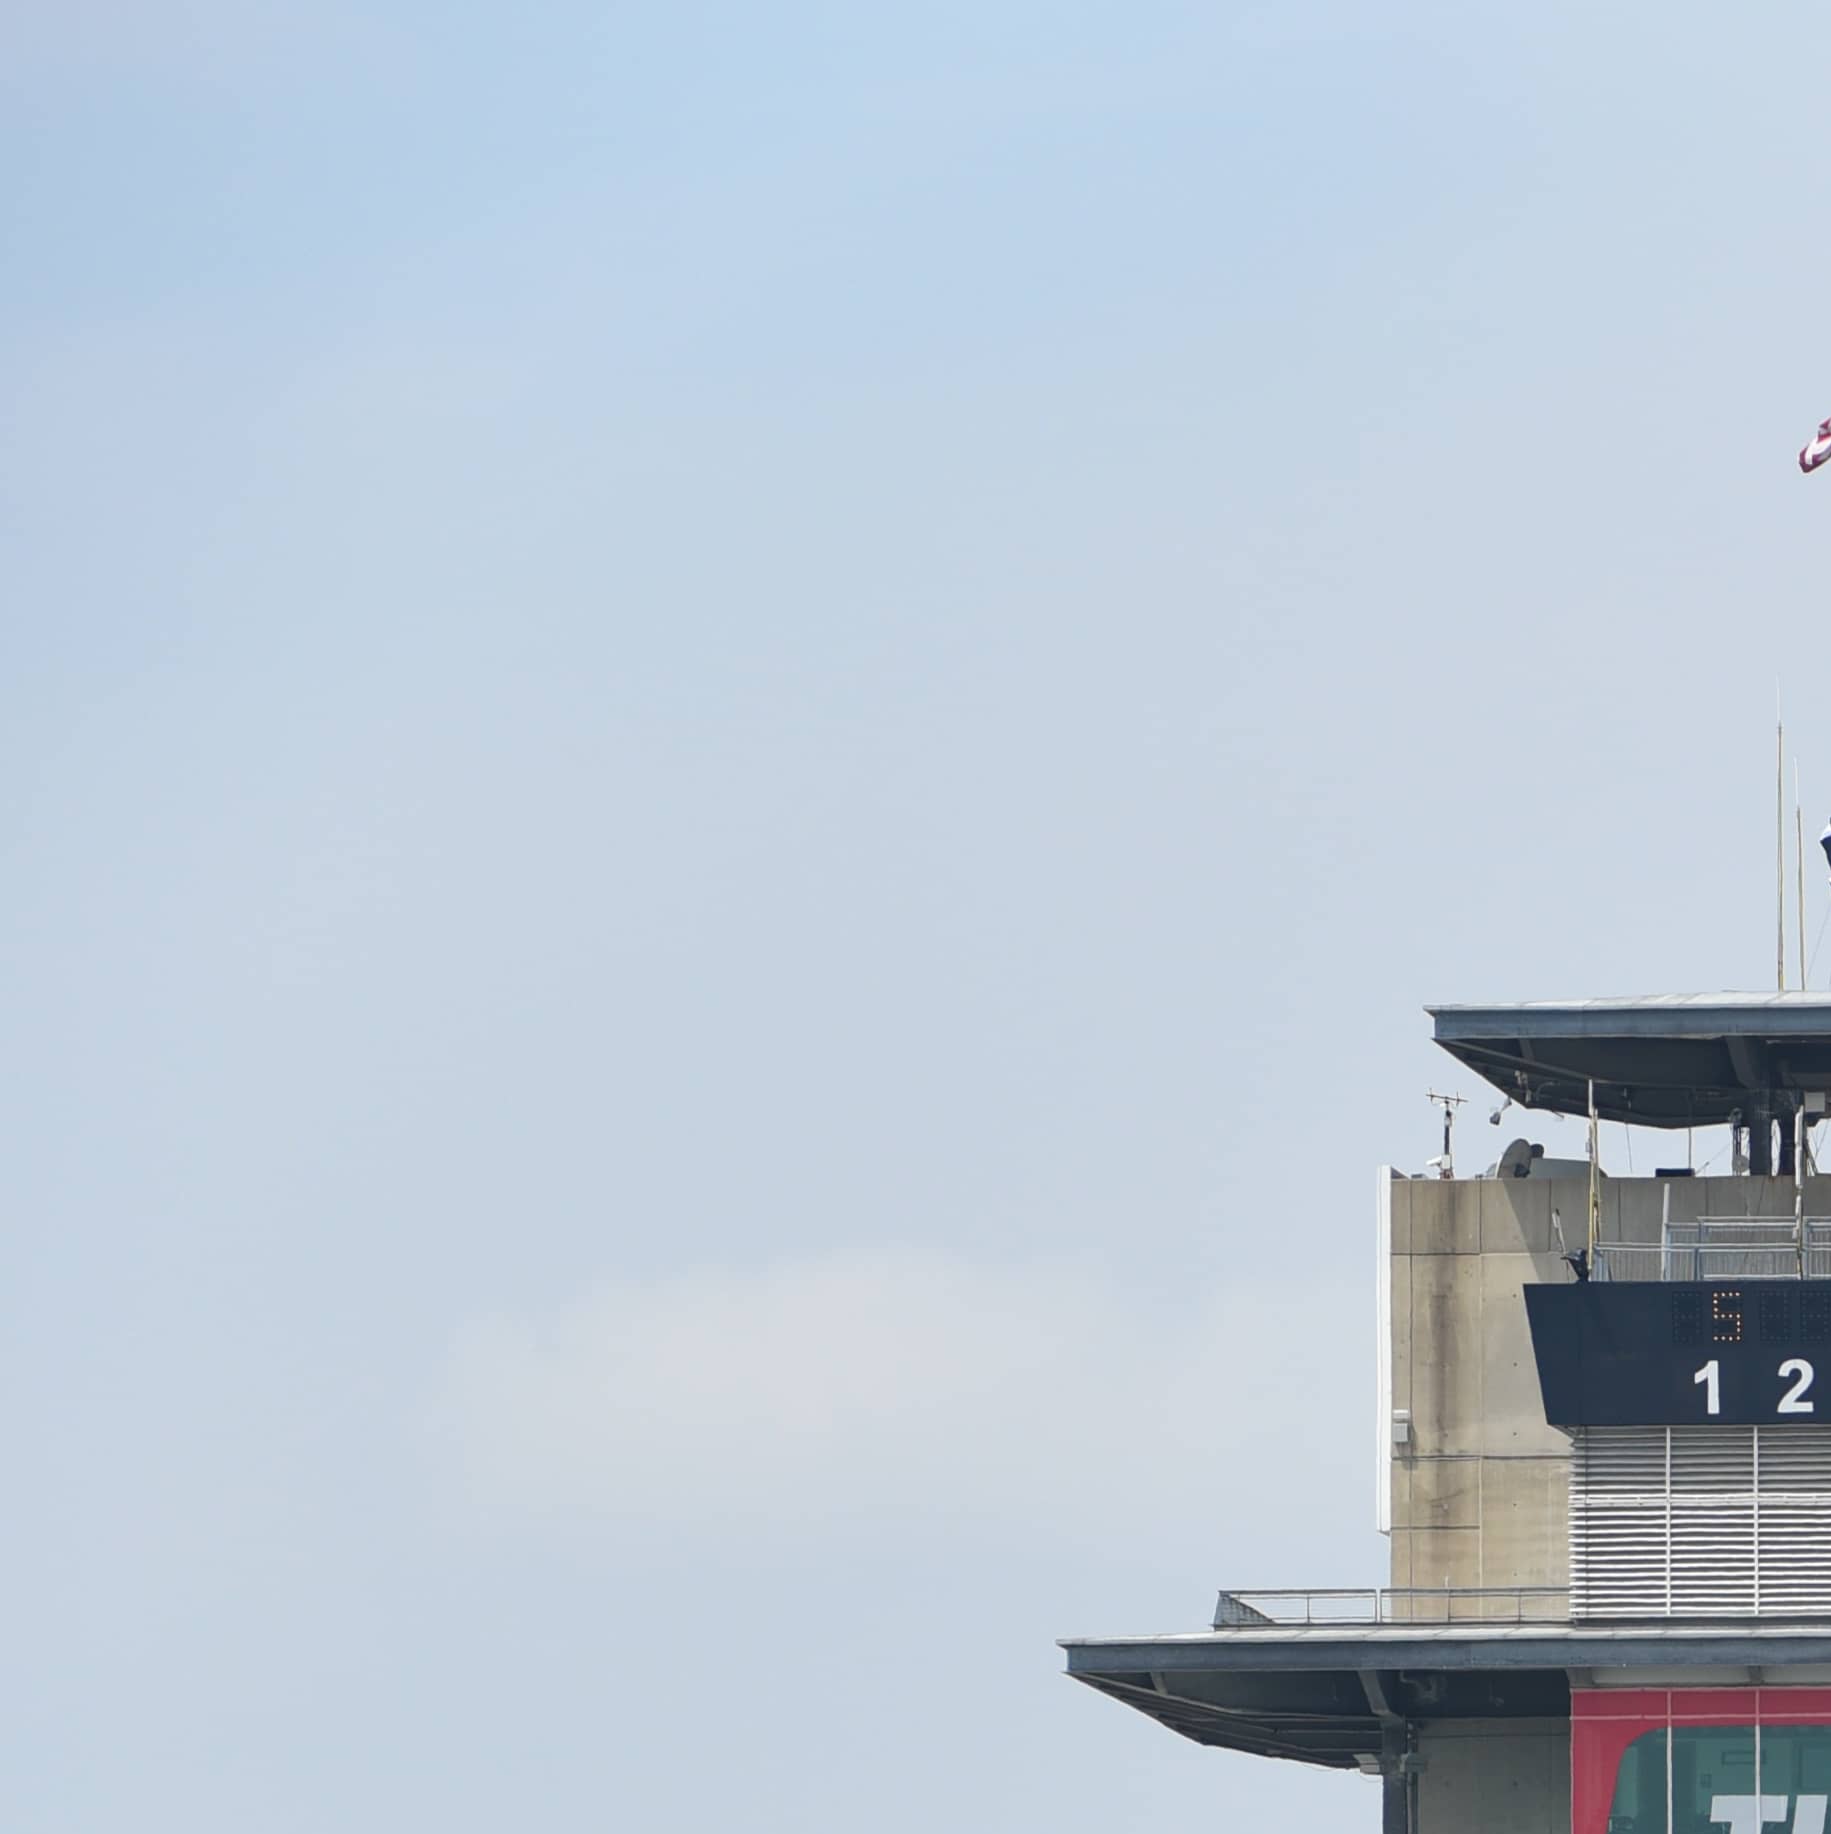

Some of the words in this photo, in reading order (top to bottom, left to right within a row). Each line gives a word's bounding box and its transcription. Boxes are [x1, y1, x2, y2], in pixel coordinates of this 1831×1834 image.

[1711, 1291, 1743, 1342] 5
[1694, 1360, 1720, 1415] 1
[1777, 1358, 1814, 1413] 2
